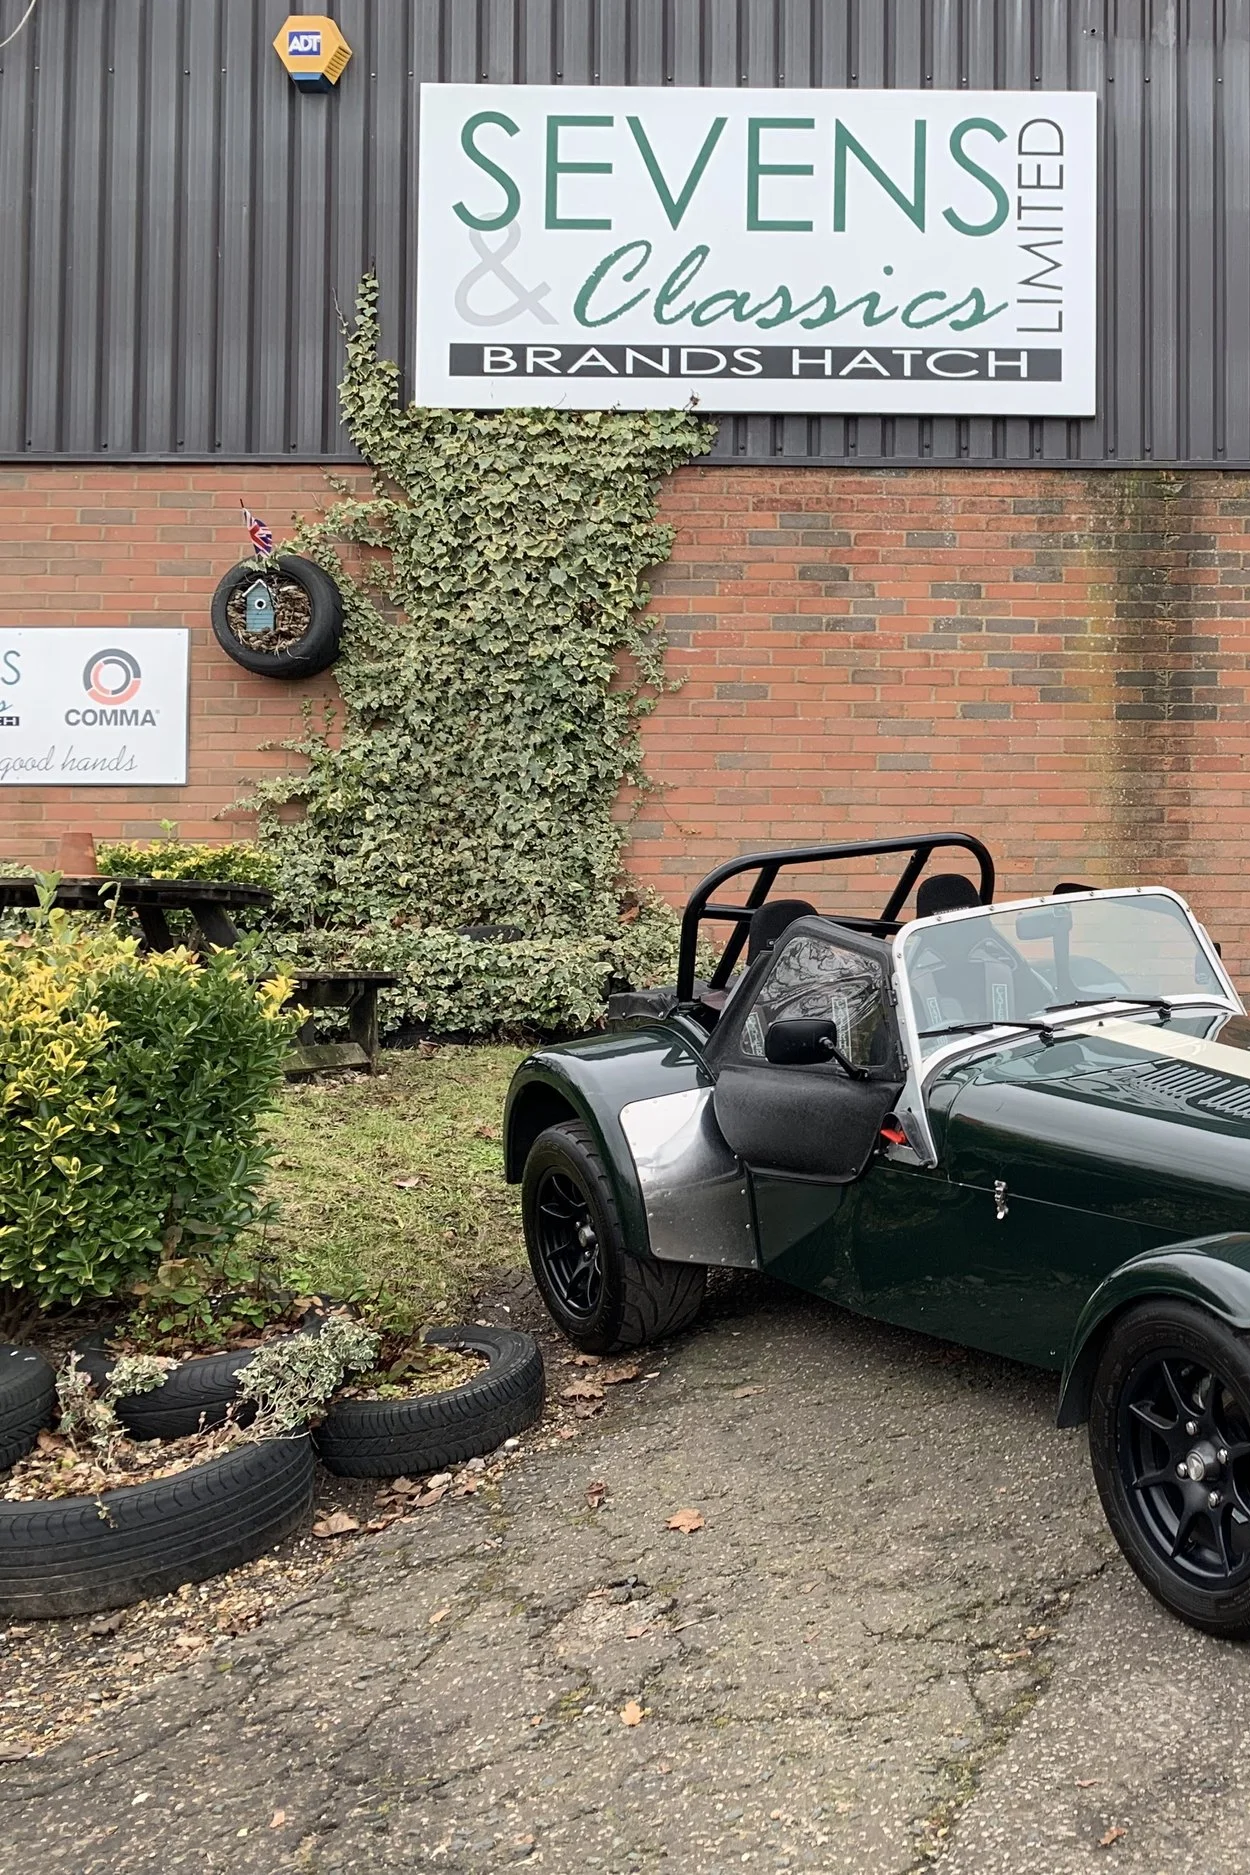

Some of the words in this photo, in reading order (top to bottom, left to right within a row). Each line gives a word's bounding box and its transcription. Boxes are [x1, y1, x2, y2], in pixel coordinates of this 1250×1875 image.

[288, 35, 321, 52] ADT
[452, 110, 1010, 237] SEVENS
[1017, 117, 1064, 333] LIMITED
[453, 212, 559, 328] &
[573, 239, 1009, 332] Classics
[482, 346, 763, 377] BRANDS
[791, 348, 1028, 379] HATCH
[64, 708, 157, 727] COMMA
[0, 745, 55, 781] good
[61, 744, 139, 772] hands
